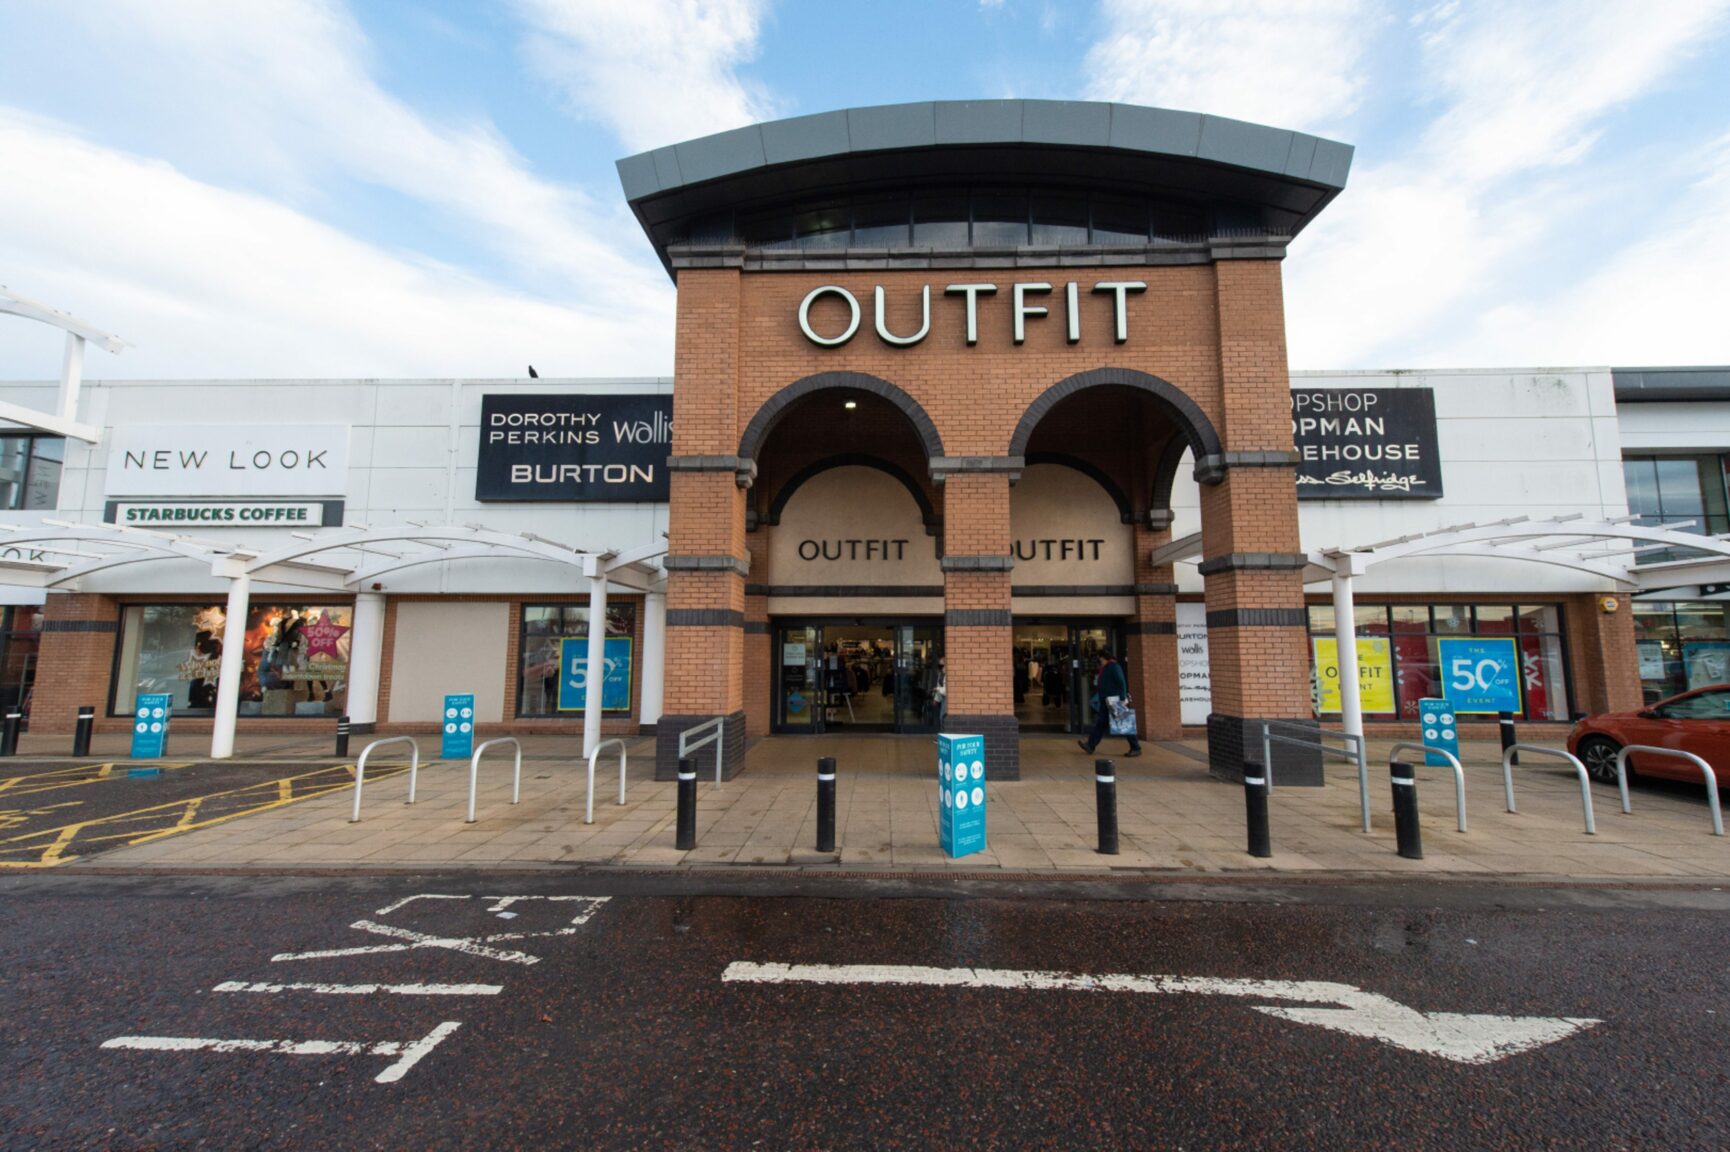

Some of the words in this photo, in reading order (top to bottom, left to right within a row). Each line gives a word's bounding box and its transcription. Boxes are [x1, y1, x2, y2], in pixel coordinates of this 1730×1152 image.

[798, 281, 1148, 348] OUTFIT
[490, 413, 602, 427] DOROTHY
[489, 430, 600, 444] PERKINS
[124, 450, 208, 470] NEW
[229, 450, 328, 470] LOOK
[1293, 444, 1420, 461] EHOUSE
[511, 464, 654, 483] BURTON
[1325, 469, 1427, 491] Selfridge
[126, 507, 235, 521] STARBUCKS
[239, 507, 307, 521] COFFEE
[798, 539, 910, 561] OUTFIT
[1009, 539, 1105, 561] UTFIT
[307, 626, 340, 638] 50%
[311, 638, 334, 647] OFF
[1325, 666, 1382, 678] OFIT
